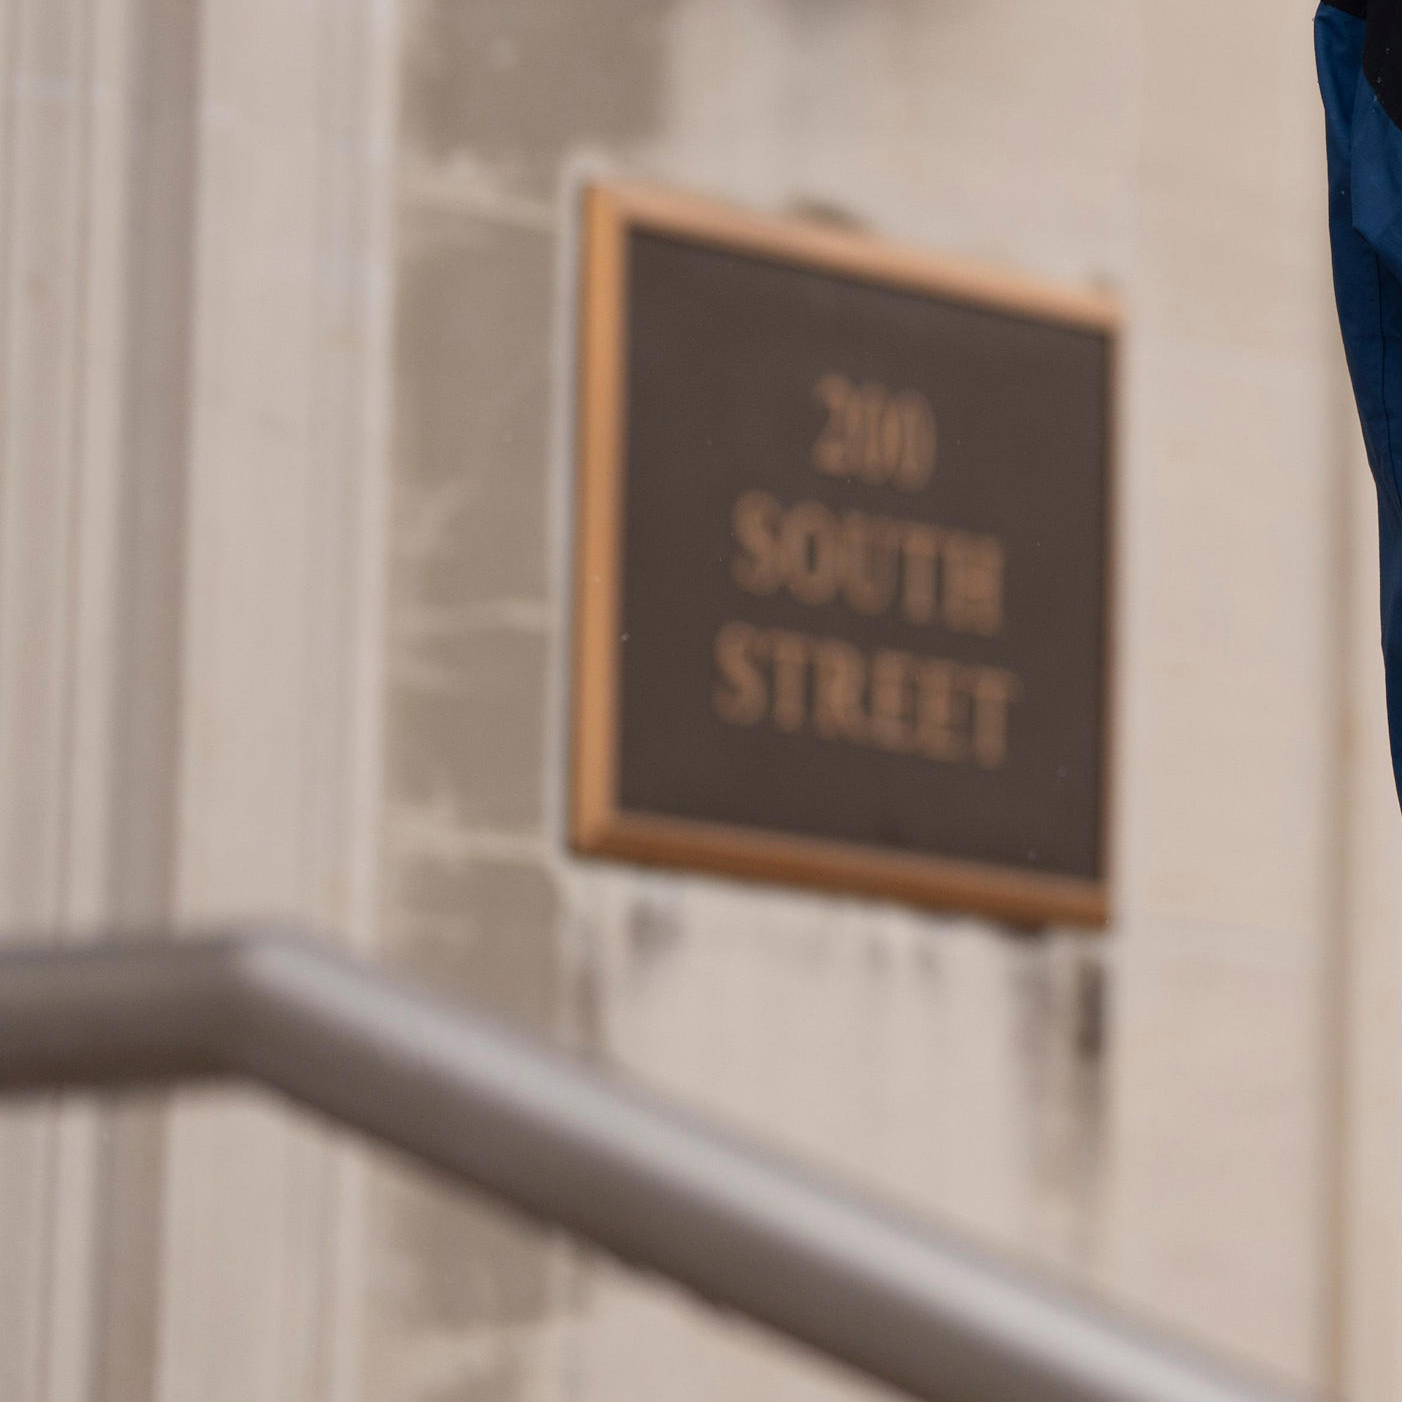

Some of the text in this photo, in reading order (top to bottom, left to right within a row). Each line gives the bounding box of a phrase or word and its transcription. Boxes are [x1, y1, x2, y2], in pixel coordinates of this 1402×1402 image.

[813, 372, 938, 494] 200
[729, 489, 1006, 638] SOUTH
[712, 620, 1024, 772] STREET
